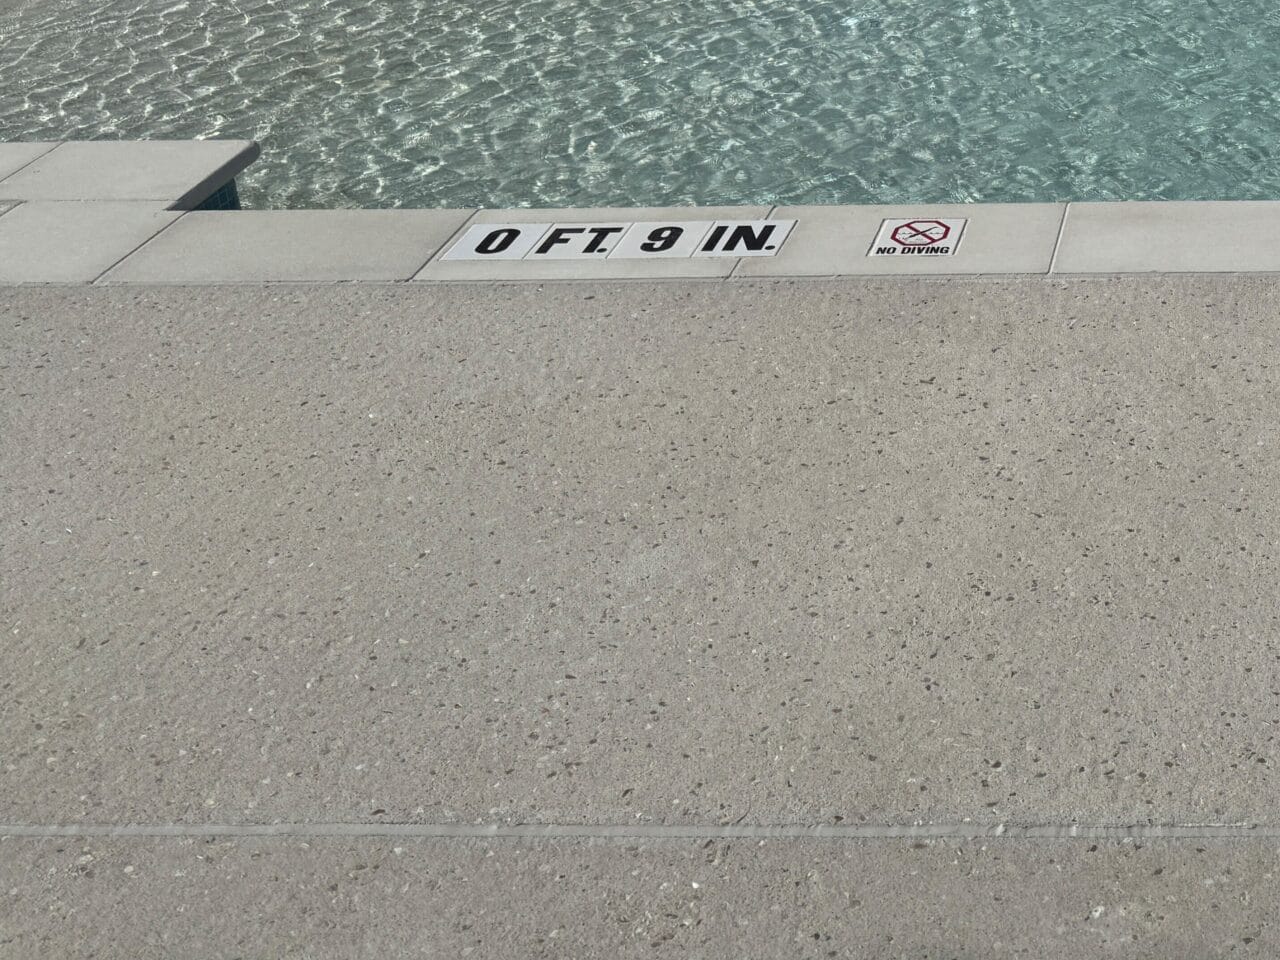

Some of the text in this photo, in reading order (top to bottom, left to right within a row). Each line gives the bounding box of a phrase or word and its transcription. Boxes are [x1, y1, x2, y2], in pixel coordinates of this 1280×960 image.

[534, 228, 624, 253] FT.
[640, 226, 684, 252] 9
[701, 226, 776, 252] IN.
[876, 246, 950, 254] NO DIVING
